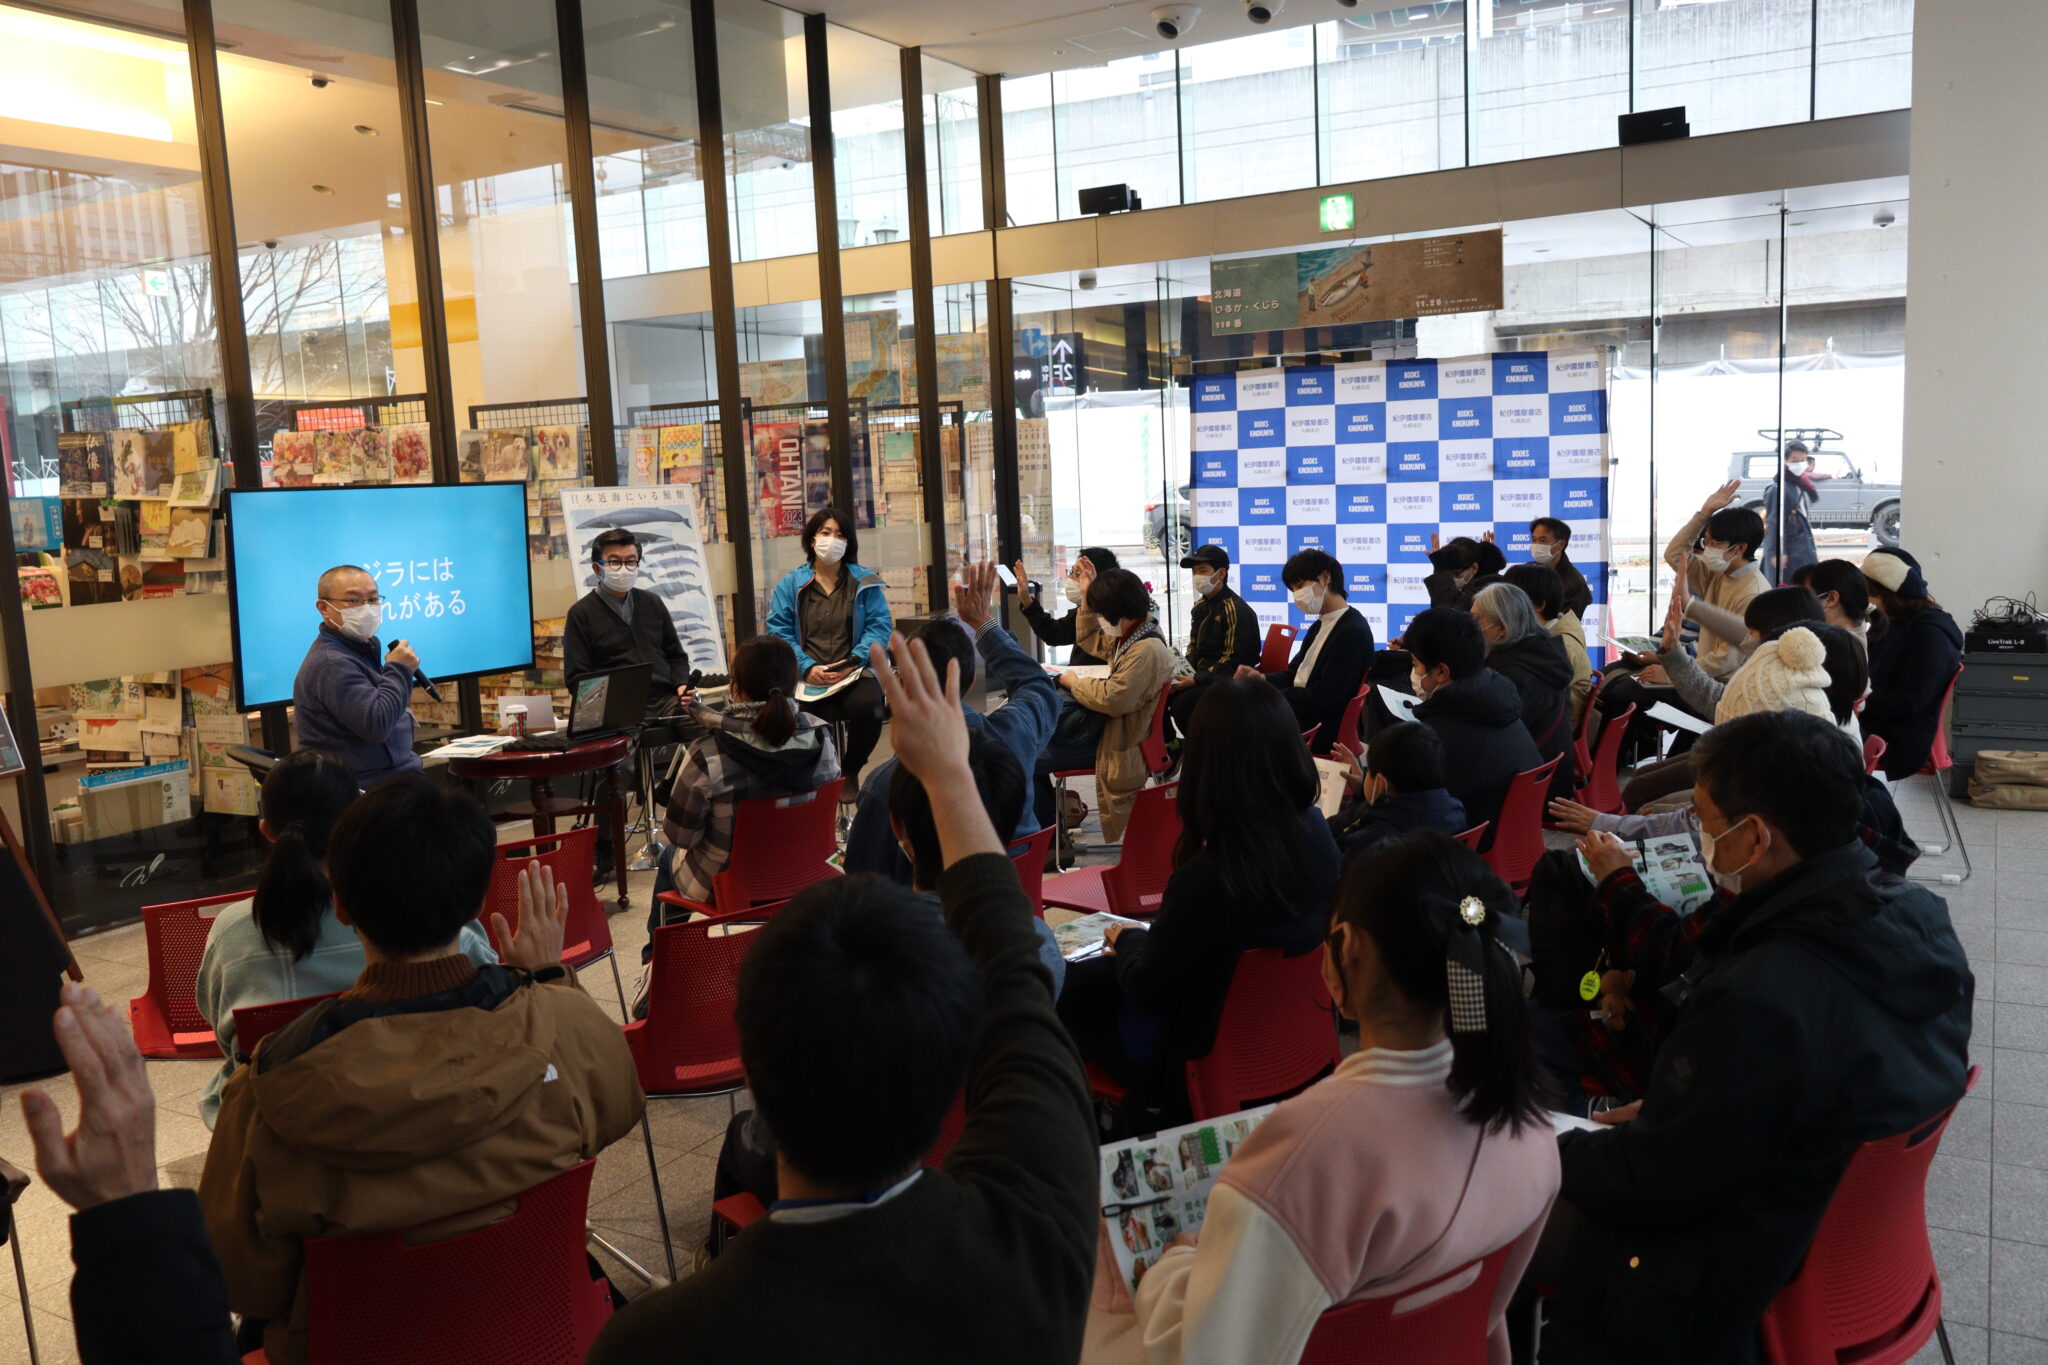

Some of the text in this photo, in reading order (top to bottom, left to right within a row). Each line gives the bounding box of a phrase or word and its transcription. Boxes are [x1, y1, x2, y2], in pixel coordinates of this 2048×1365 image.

[1511, 365, 1528, 373] BOOKS
[1569, 404, 1586, 412] BOOKS
[778, 438, 803, 510] OHTANI
[781, 509, 803, 523] 2023
[363, 556, 454, 587] ジラには
[380, 589, 466, 623] れがある
